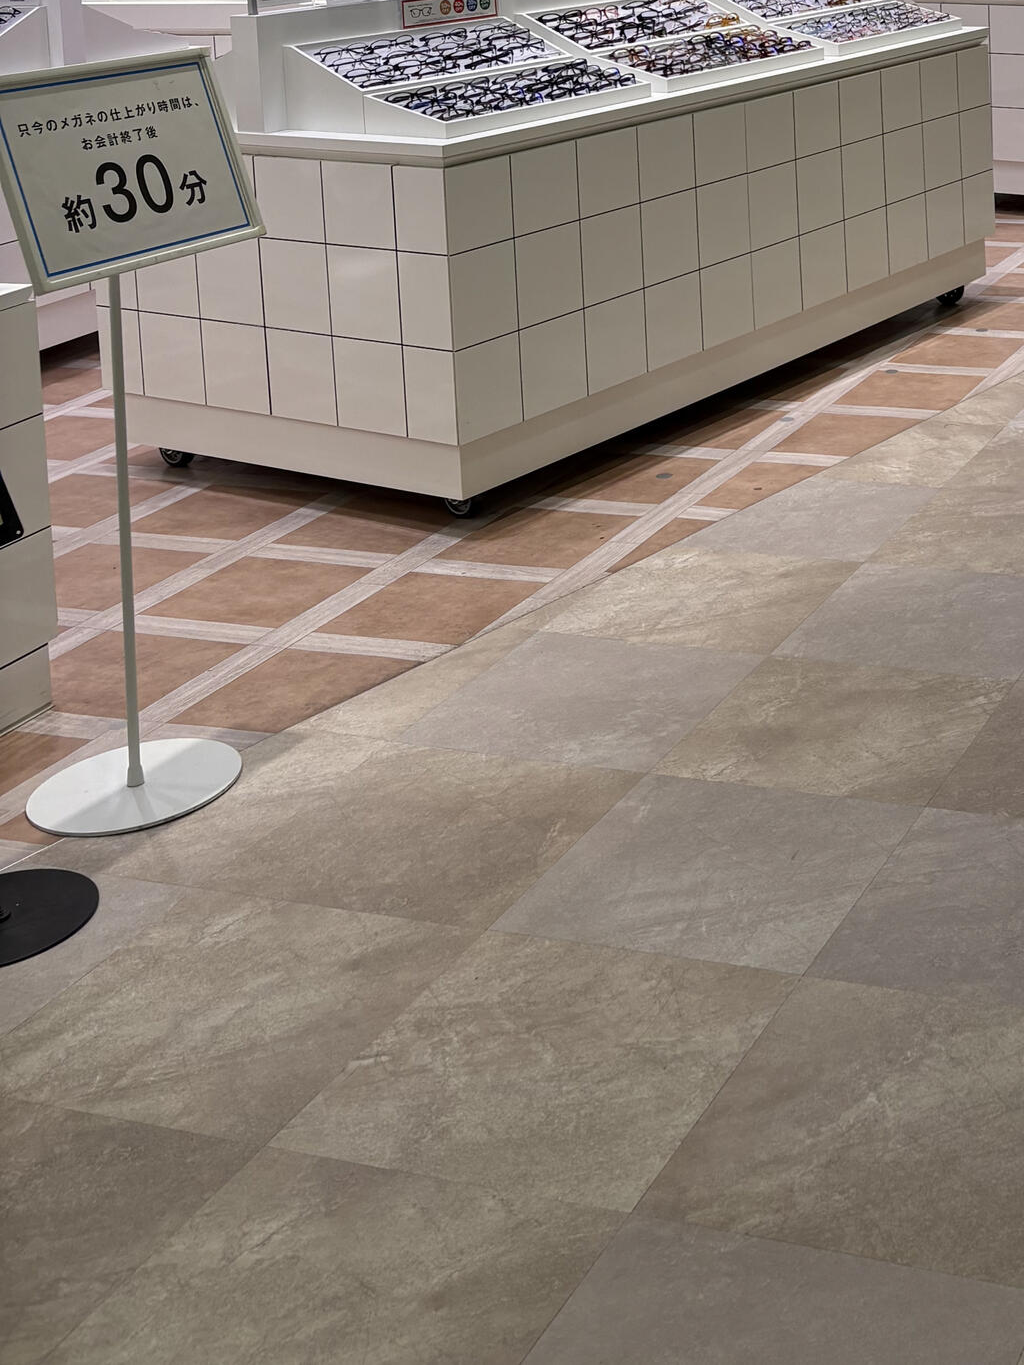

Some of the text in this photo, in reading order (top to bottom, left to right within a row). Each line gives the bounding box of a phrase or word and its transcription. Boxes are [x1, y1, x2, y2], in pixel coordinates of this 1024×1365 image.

[17, 96, 200, 138] 只今のメガネの仕上がり時間は、
[81, 126, 159, 151] お会計終了後
[61, 154, 208, 234] 約30分
